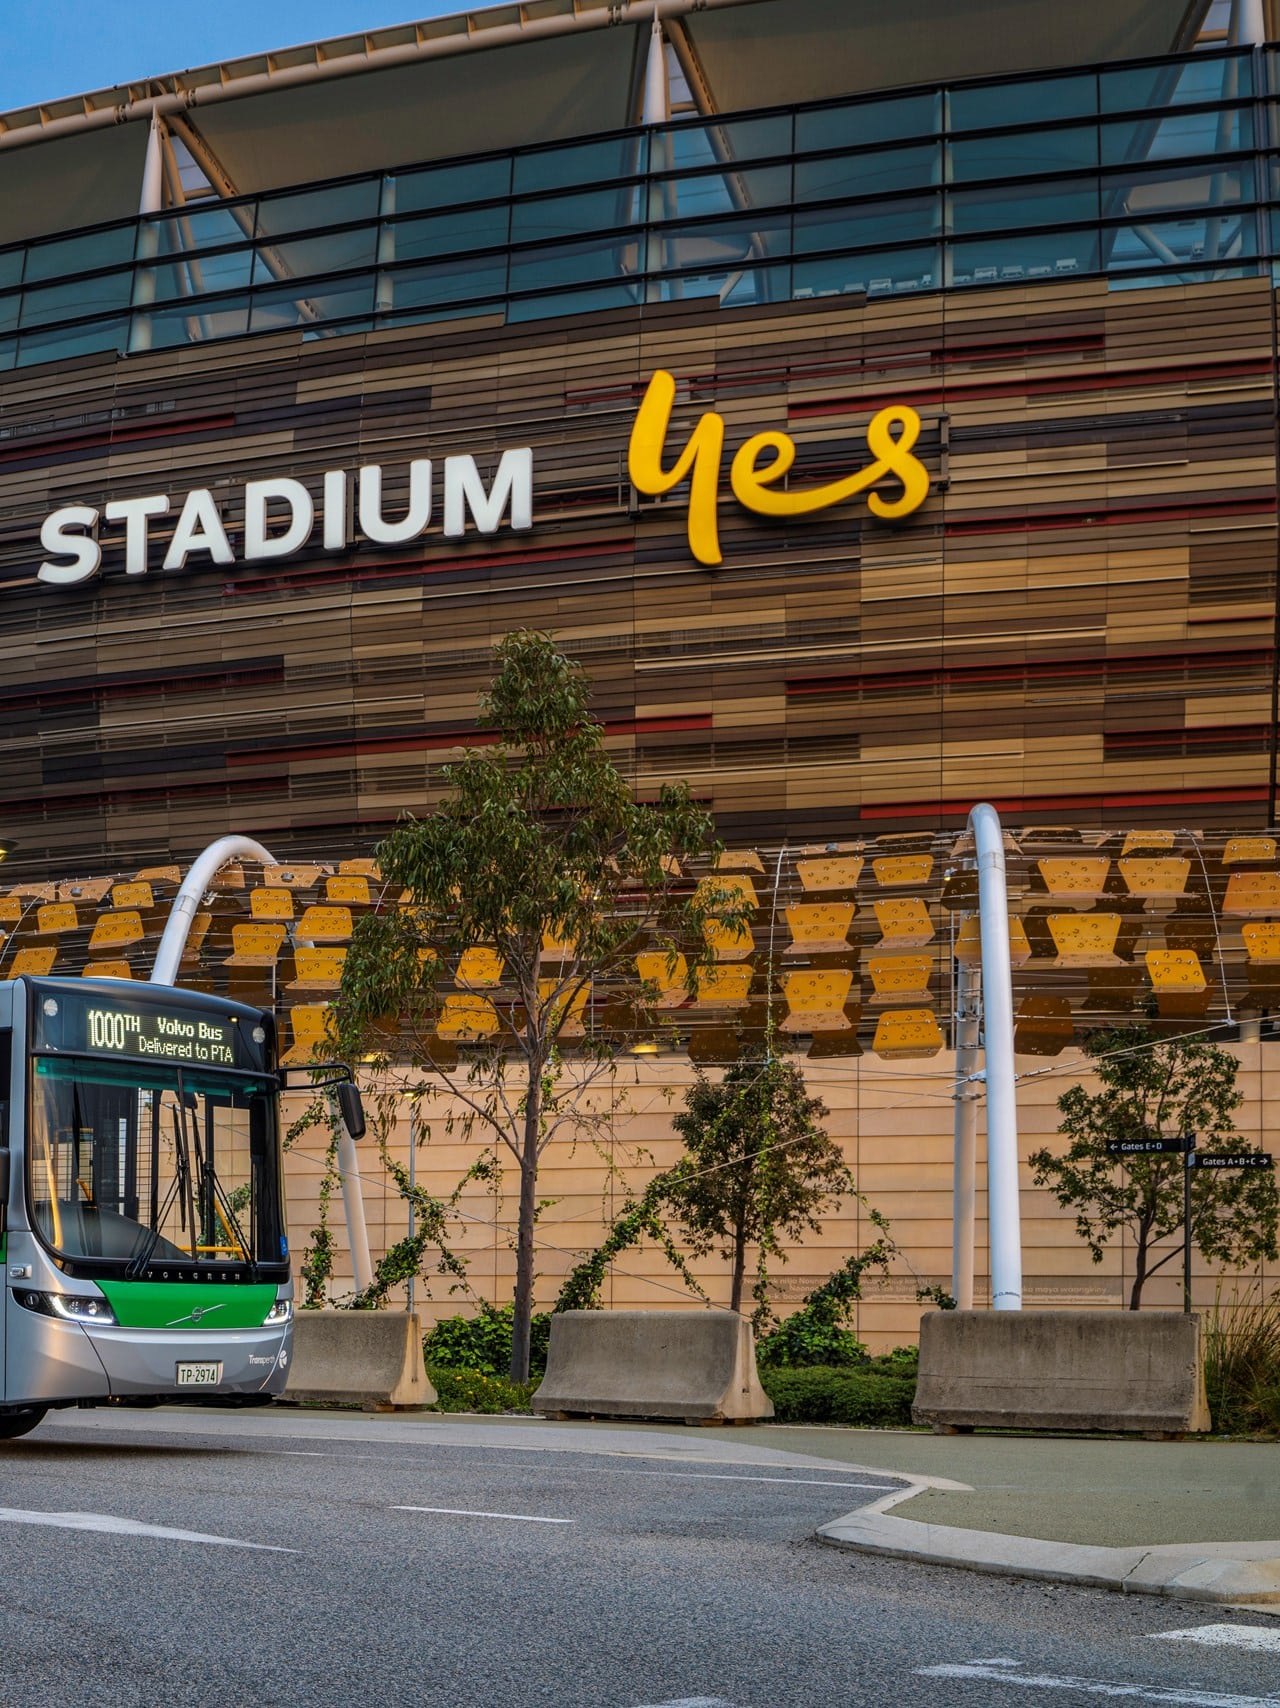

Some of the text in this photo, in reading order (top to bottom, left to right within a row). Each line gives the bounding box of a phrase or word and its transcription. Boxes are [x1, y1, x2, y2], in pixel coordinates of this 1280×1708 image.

[628, 369, 930, 565] yes
[37, 446, 533, 585] STADIUM
[157, 1017, 194, 1037] Volvo
[198, 1023, 223, 1040] Bus
[139, 1036, 233, 1062] Delivered to PTA
[1121, 1142, 1144, 1150] Gates
[1202, 1158, 1225, 1166] Gates
[147, 1271, 240, 1280] VOLGREN
